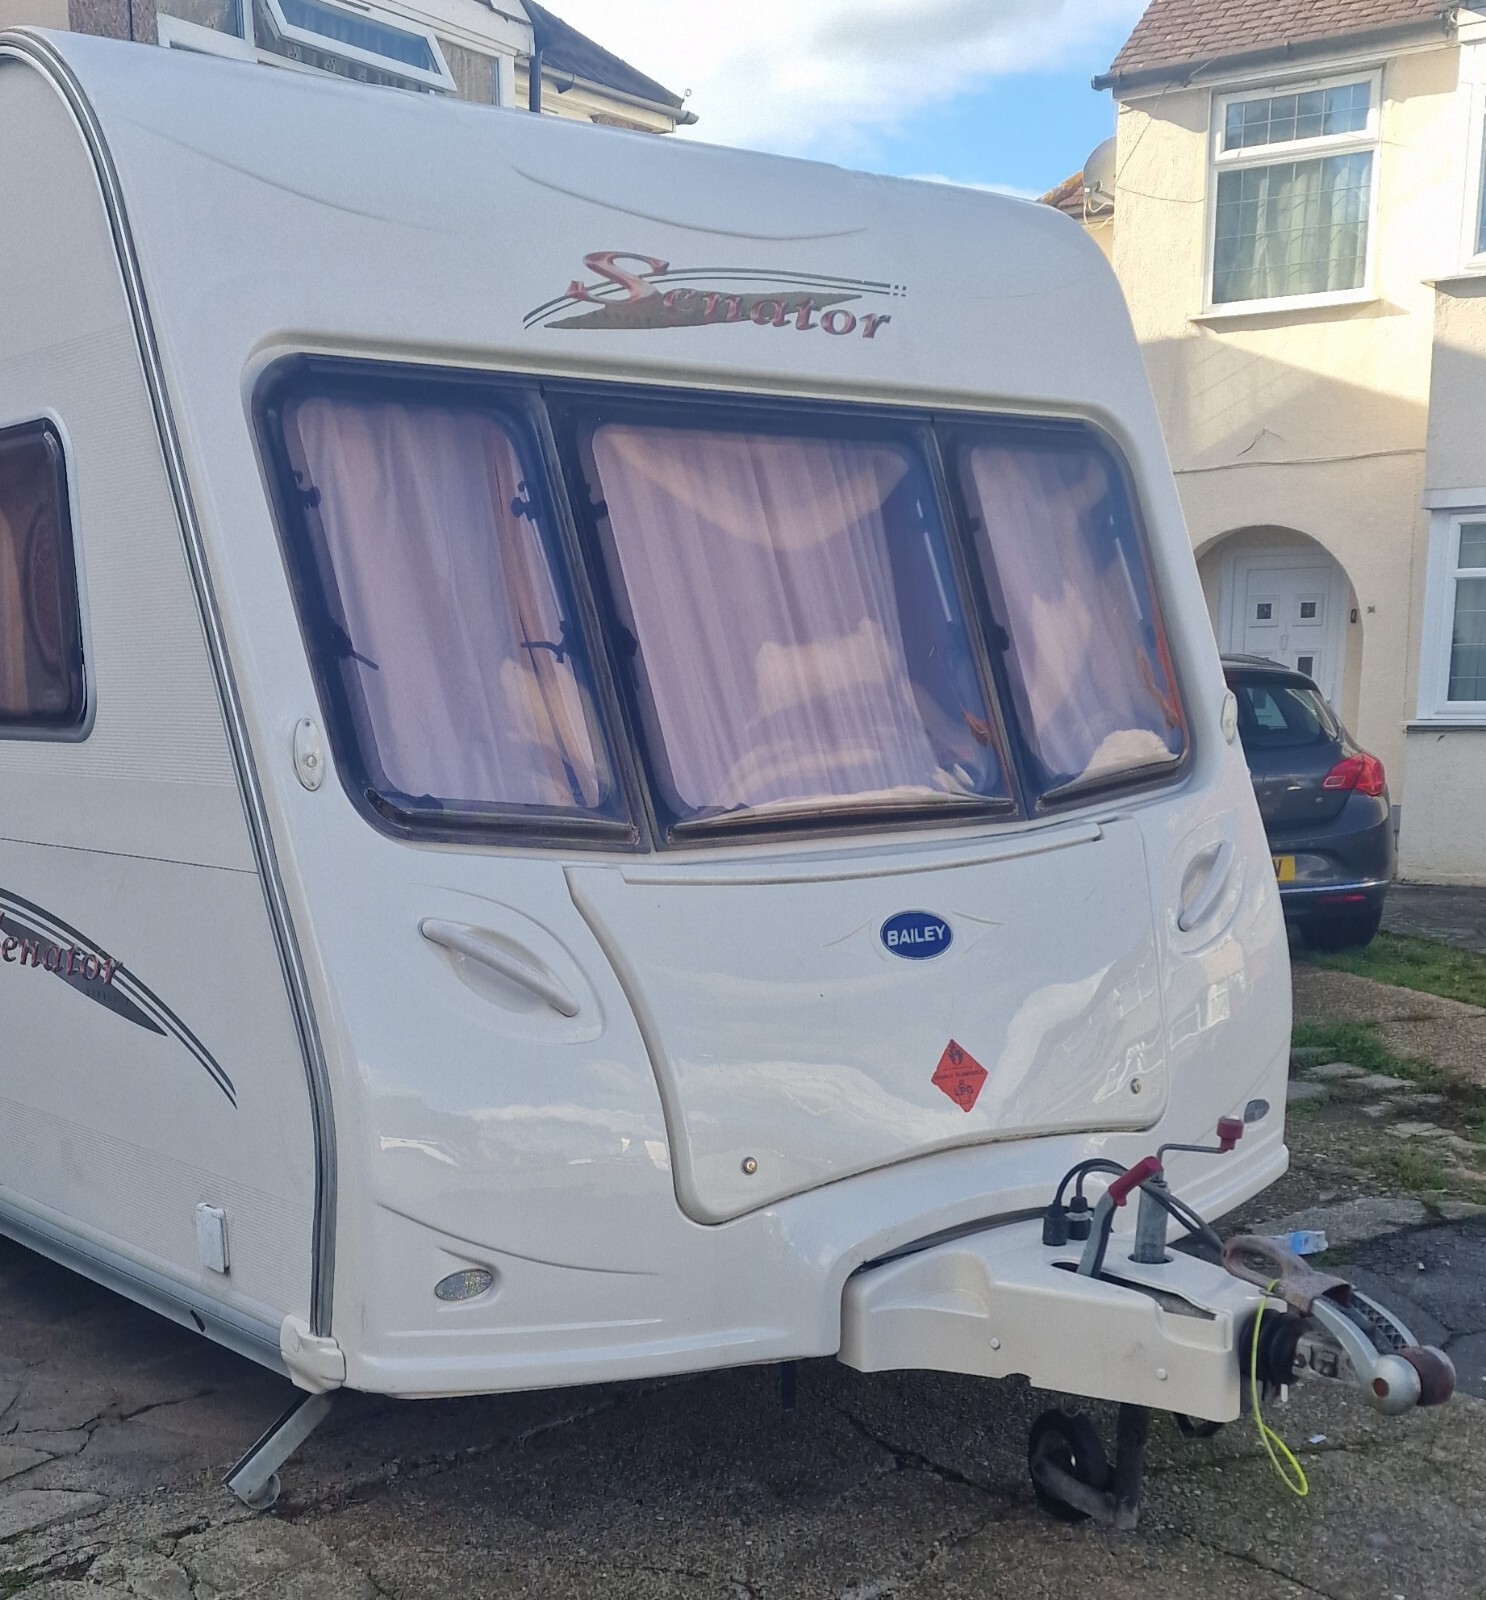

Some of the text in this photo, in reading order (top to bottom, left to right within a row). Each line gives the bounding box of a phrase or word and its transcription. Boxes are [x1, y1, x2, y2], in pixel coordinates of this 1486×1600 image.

[565, 250, 892, 339] Senator
[0, 911, 123, 986] enator
[886, 924, 947, 947] BAILEY
[953, 1084, 974, 1097] LPG
